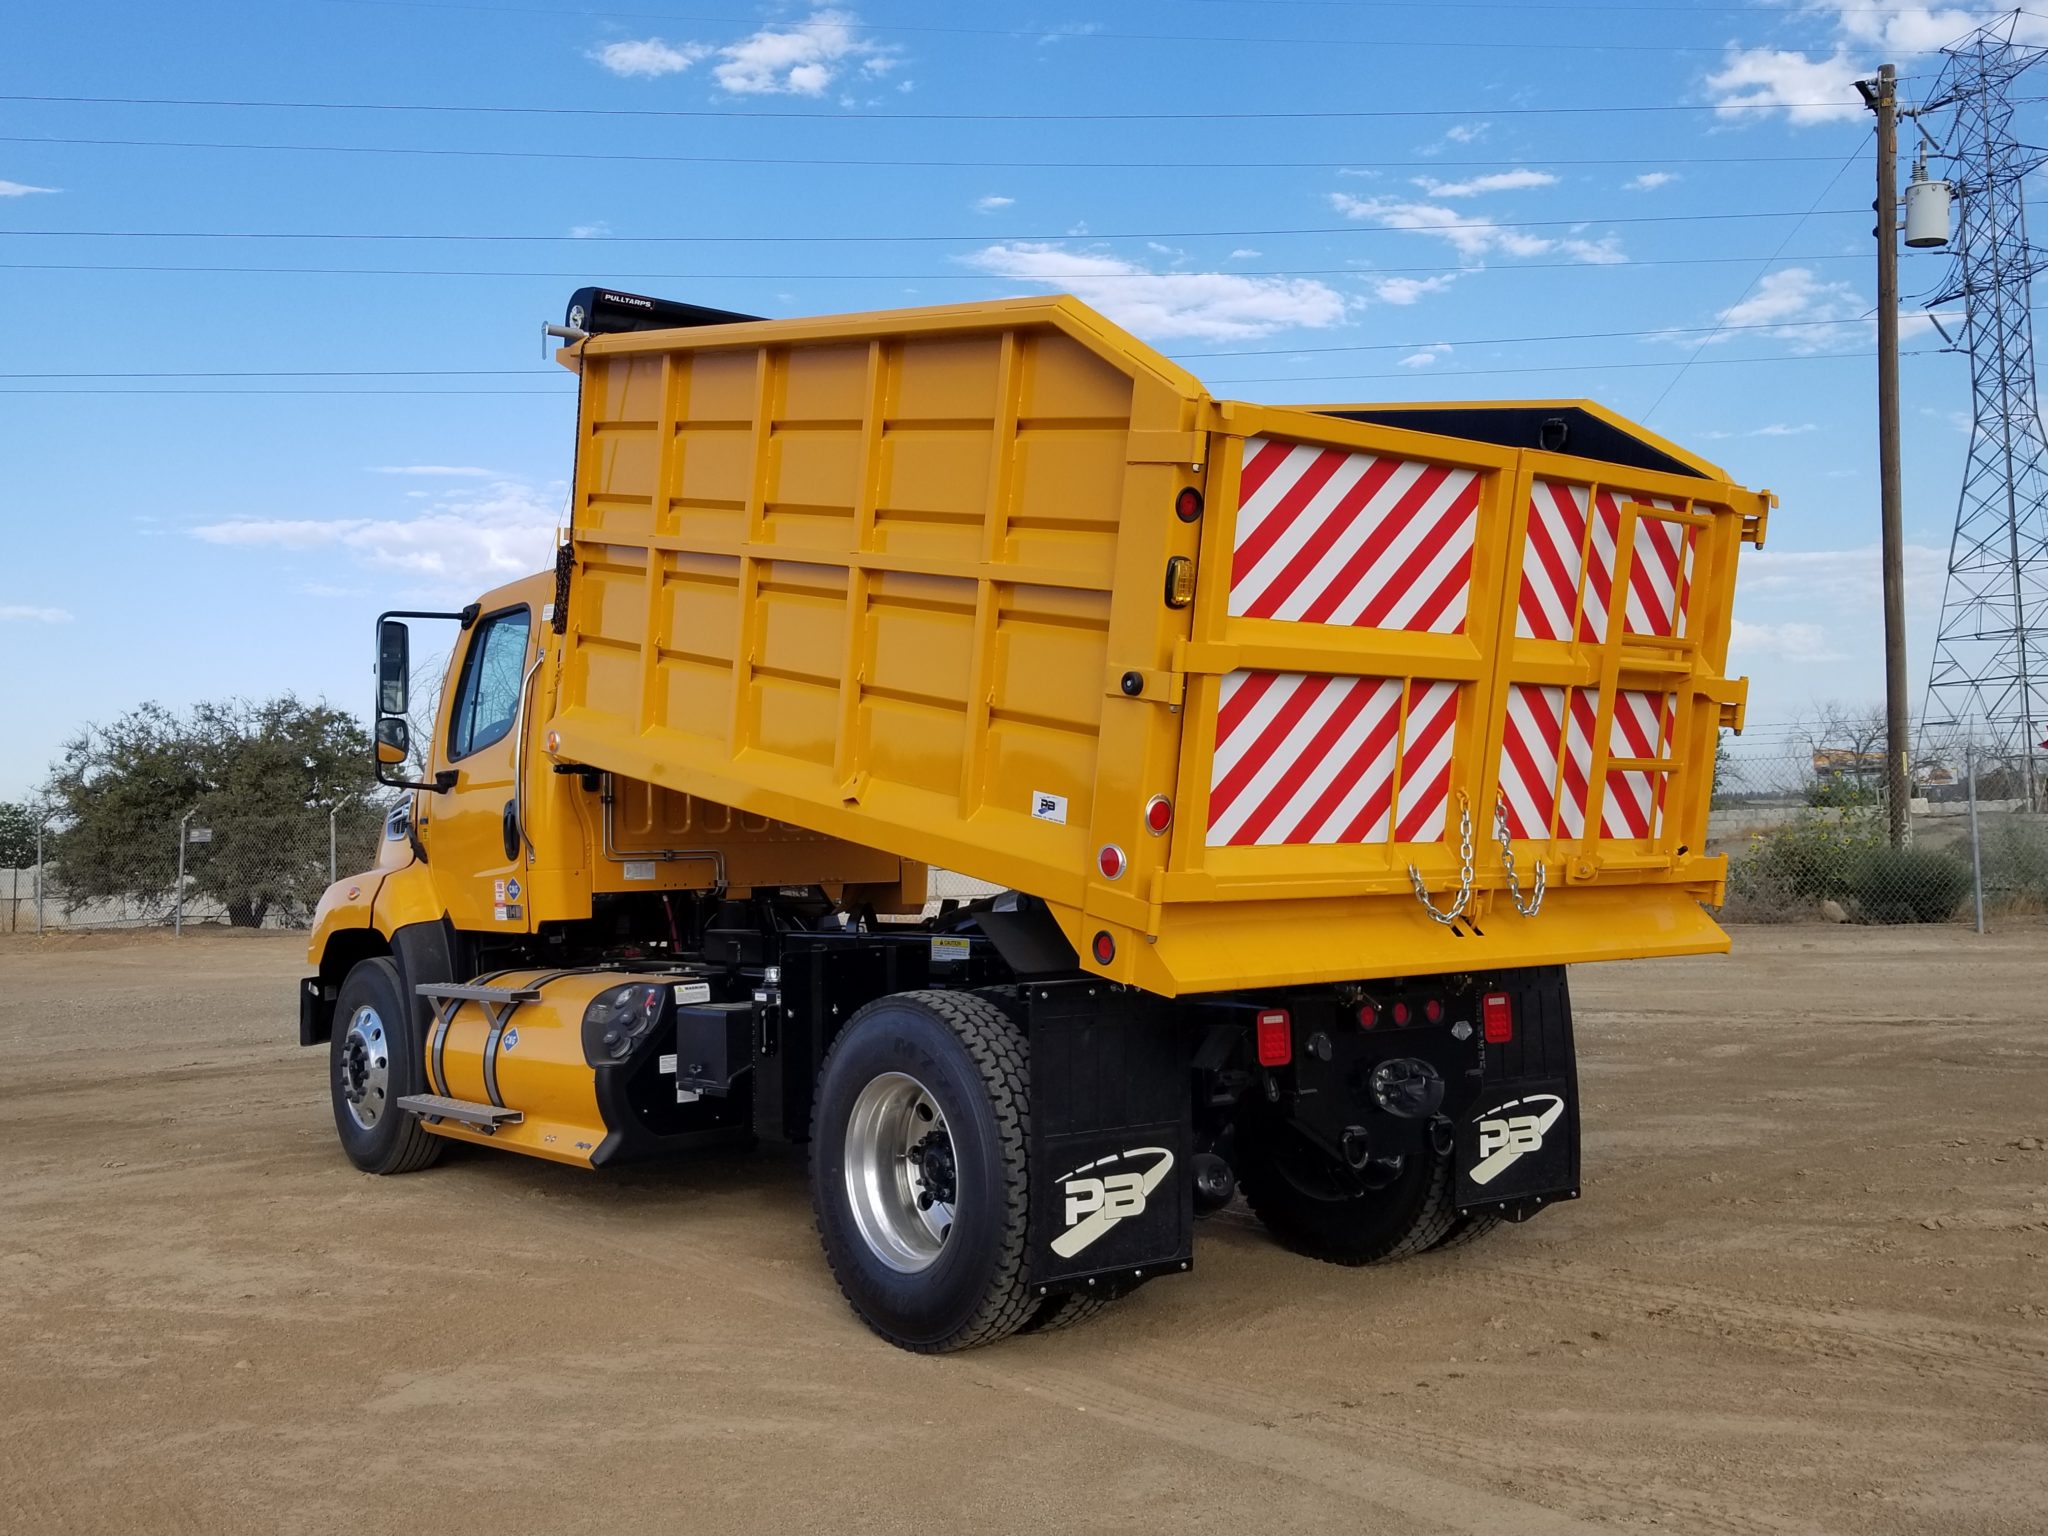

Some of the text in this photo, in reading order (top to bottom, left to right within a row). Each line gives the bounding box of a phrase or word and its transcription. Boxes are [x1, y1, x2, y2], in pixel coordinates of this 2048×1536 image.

[604, 294, 652, 308] PULLTARPS
[1040, 798, 1056, 812] PB
[508, 884, 519, 894] CNG
[505, 1034, 516, 1045] CNG
[1480, 1115, 1543, 1158] PB
[1065, 1172, 1146, 1226] PB
